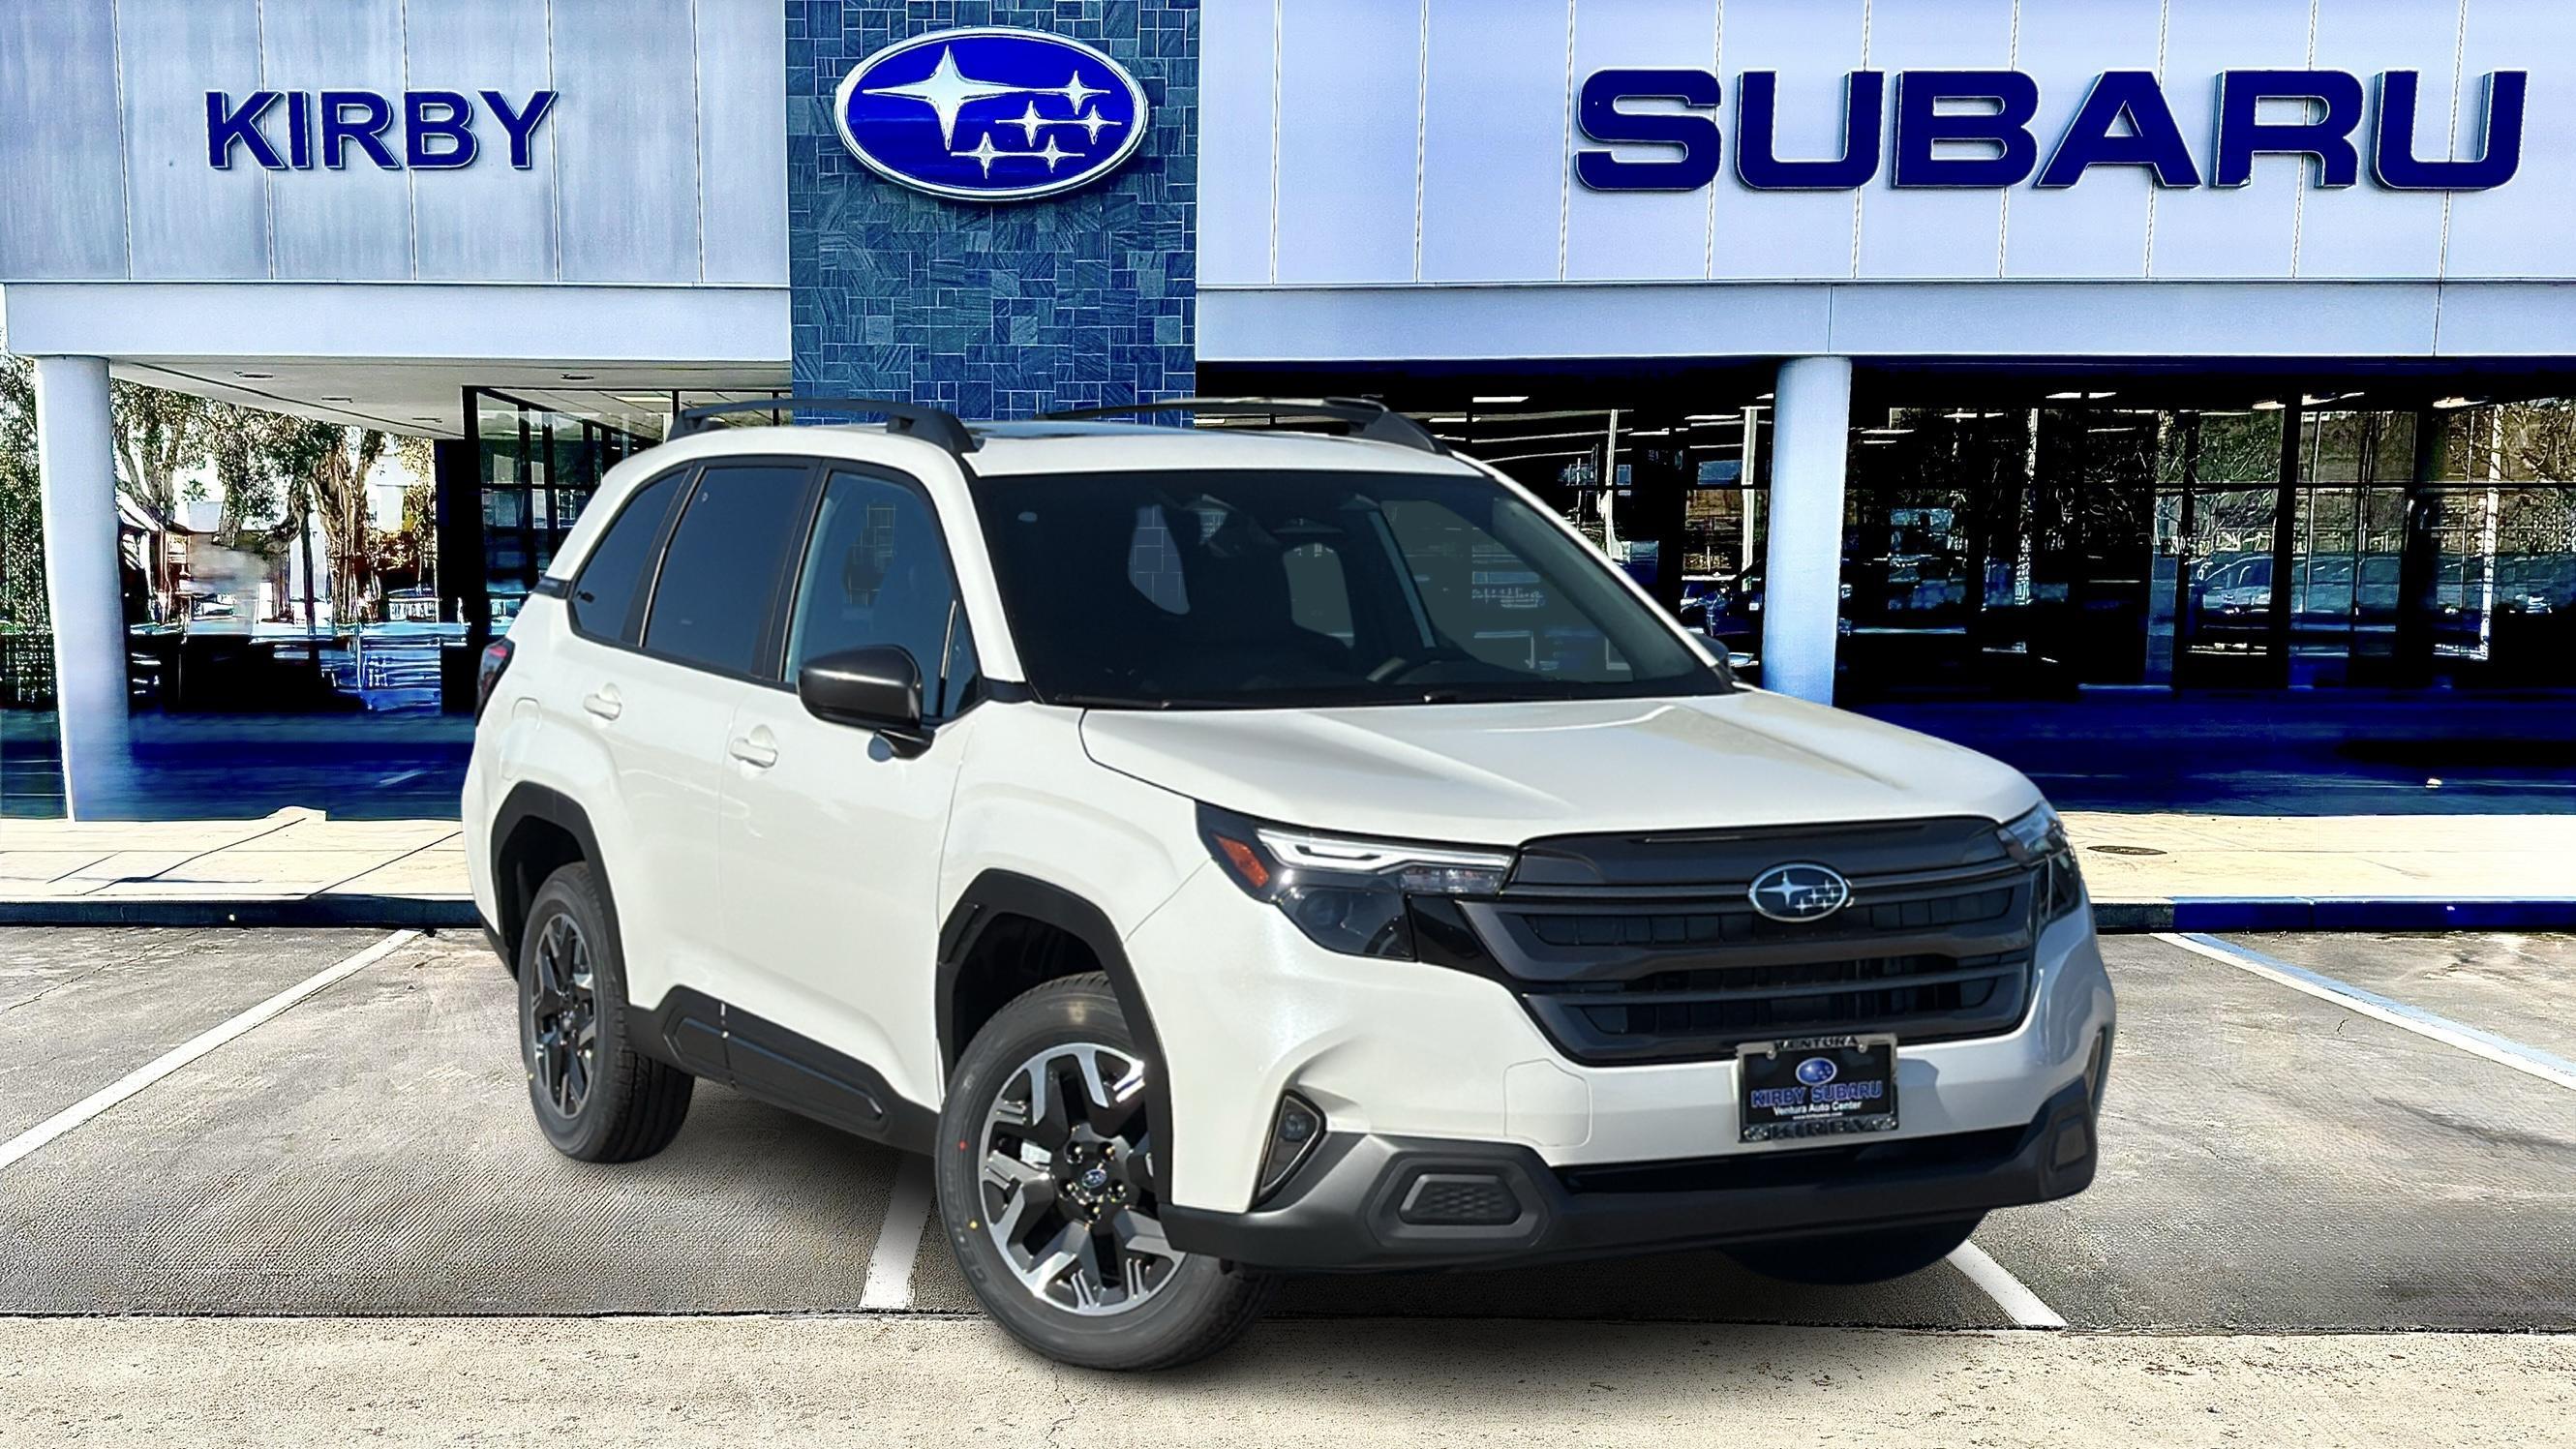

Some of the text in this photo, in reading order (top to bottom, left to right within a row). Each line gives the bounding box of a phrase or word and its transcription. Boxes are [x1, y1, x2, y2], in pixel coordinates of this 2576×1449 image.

[204, 90, 559, 170] KIRBY
[1575, 69, 2528, 192] SUBARU
[1773, 1036, 1858, 1051] VENTURA
[1751, 1080, 1883, 1107] KIRBY SUBARU
[1773, 1103, 1807, 1116] Ventura
[1808, 1102, 1830, 1113] Auto
[1832, 1100, 1863, 1111] Center
[1772, 1117, 1872, 1139] KIRBY
